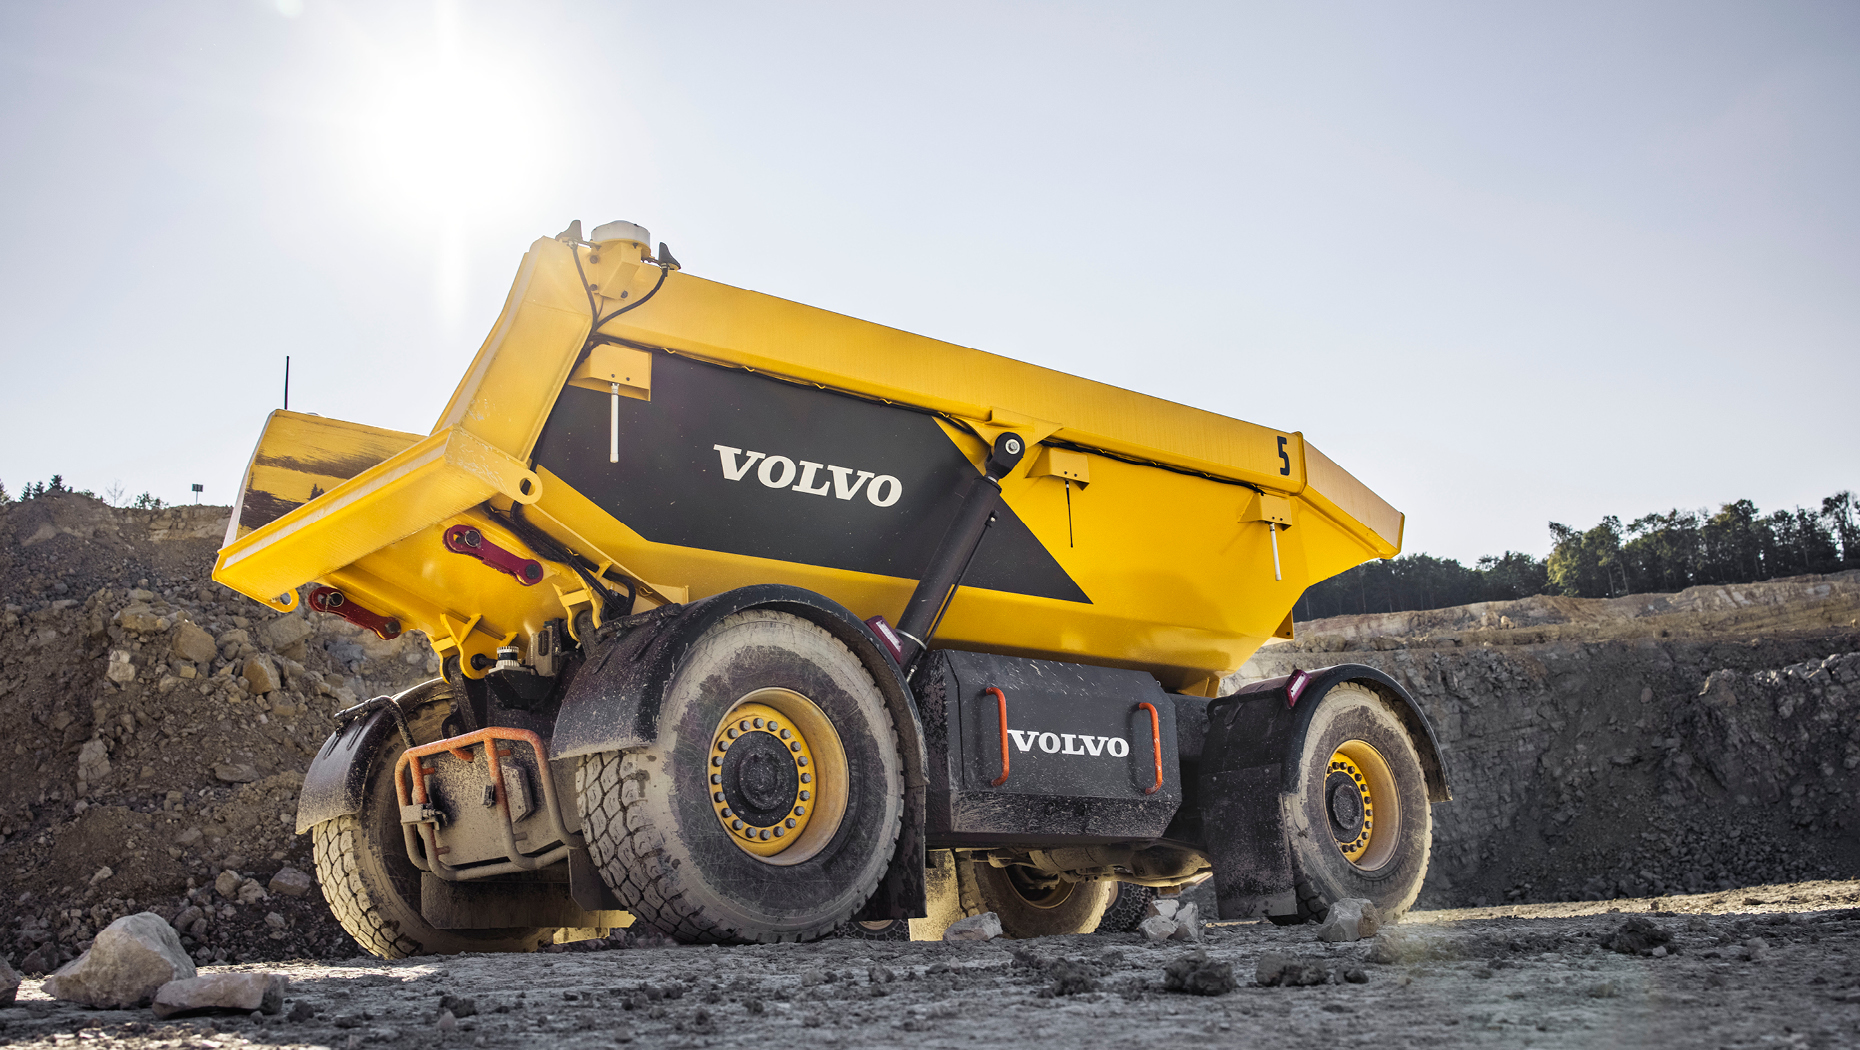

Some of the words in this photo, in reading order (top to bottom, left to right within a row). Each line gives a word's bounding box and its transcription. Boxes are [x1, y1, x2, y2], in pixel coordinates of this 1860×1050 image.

[713, 444, 903, 508] VOLVO
[1277, 435, 1291, 477] 5
[1007, 729, 1130, 758] VOLVO
